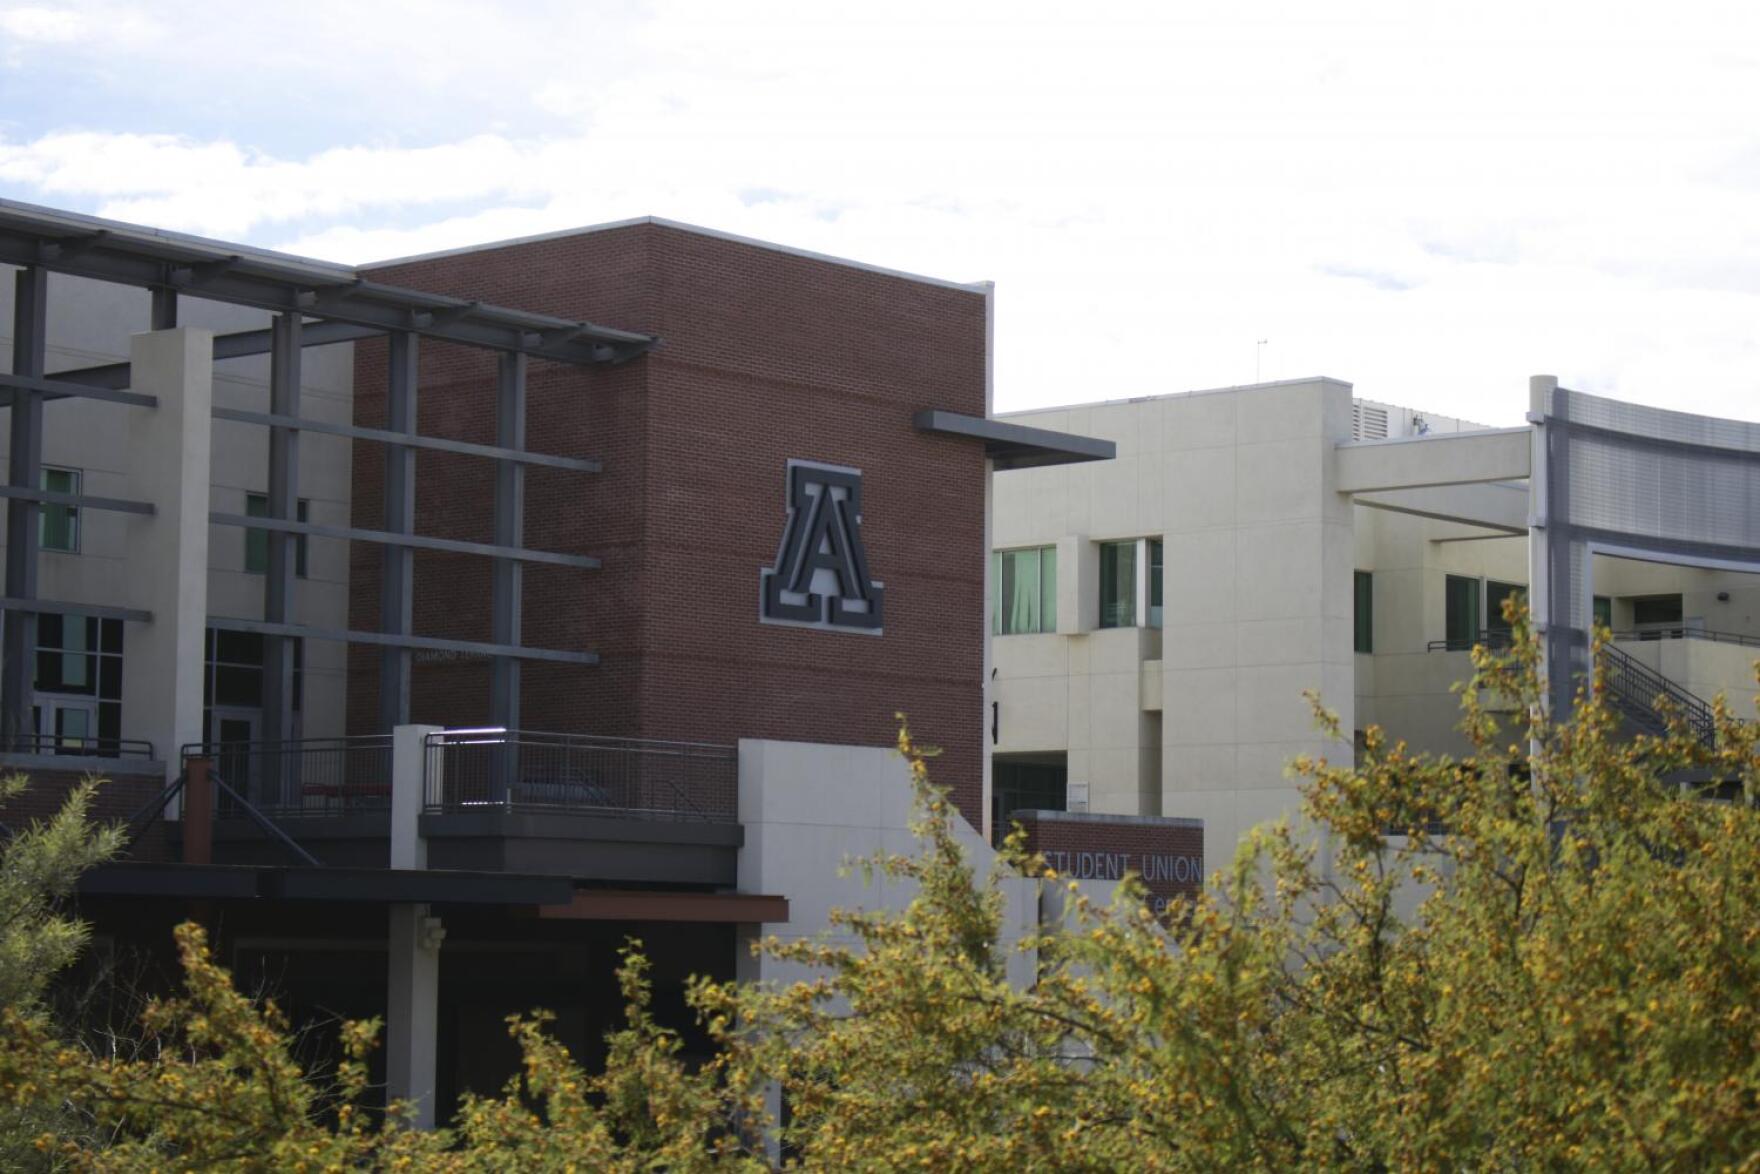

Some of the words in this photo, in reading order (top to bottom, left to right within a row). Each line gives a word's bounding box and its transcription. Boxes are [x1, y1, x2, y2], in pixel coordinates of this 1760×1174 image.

[760, 458, 885, 636] A
[1044, 851, 1131, 880] STUDENT
[1142, 854, 1201, 882] UNION
